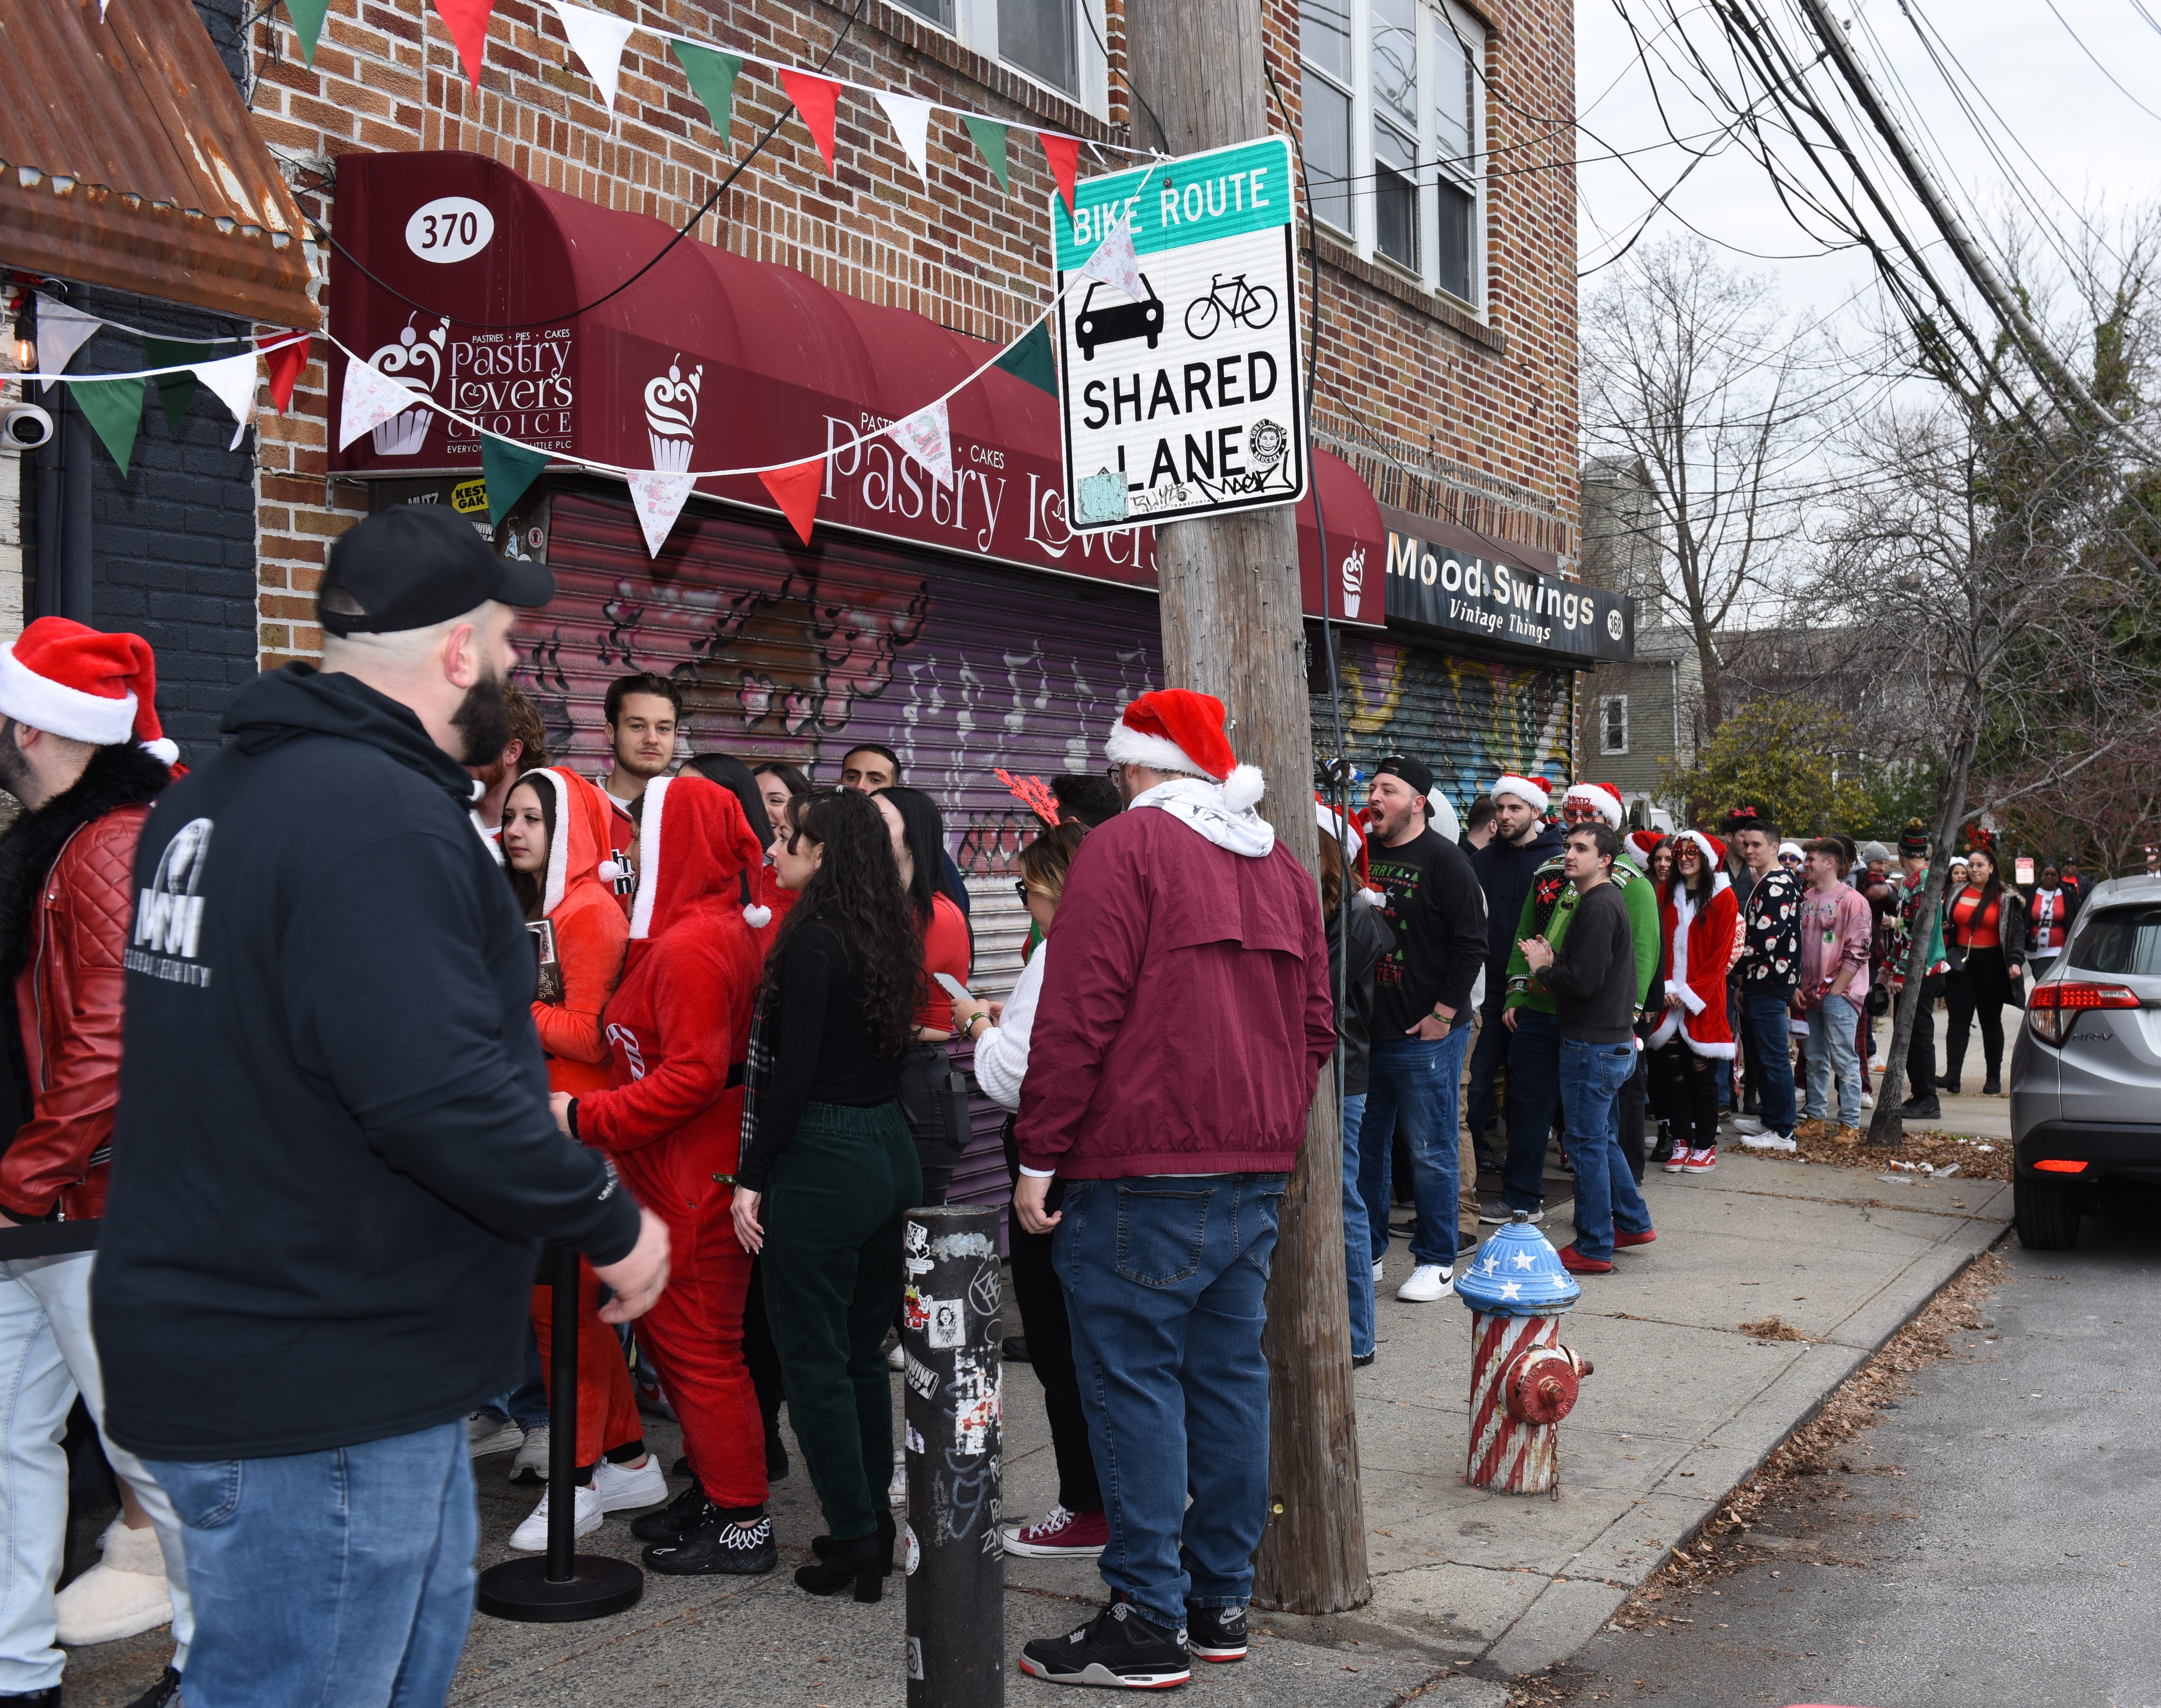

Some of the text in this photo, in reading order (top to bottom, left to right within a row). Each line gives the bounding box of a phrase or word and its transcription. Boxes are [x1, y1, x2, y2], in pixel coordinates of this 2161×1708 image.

[1074, 168, 1269, 246] BIKE ROUTE
[422, 212, 478, 248] 370
[472, 329, 570, 343] PASTRIES PIES CAKES
[449, 333, 572, 379] Pastry
[1083, 351, 1277, 429] SHARED
[448, 411, 571, 437] CHOICE
[1250, 420, 1266, 439] CONEY
[447, 444, 482, 453] EVERYON
[556, 440, 572, 449] PLC
[971, 445, 1005, 469] CAKES
[1117, 425, 1246, 493] LANE
[1253, 451, 1281, 464] SAUCERY
[455, 484, 487, 499] KEST
[821, 415, 1006, 552] Pastry
[458, 495, 486, 509] GAK
[1171, 497, 1225, 508] TRANSPORTAON
[1386, 532, 1594, 630] Mood Swings
[1450, 598, 1551, 643] Vintage Things
[1609, 614, 1622, 634] 368
[1568, 795, 1591, 803] Merry
[1368, 864, 1396, 877] ERRY
[2072, 1033, 2115, 1042] HR-V
[908, 1528, 918, 1550] LOVE
[1223, 1606, 1242, 1617] NIKE
